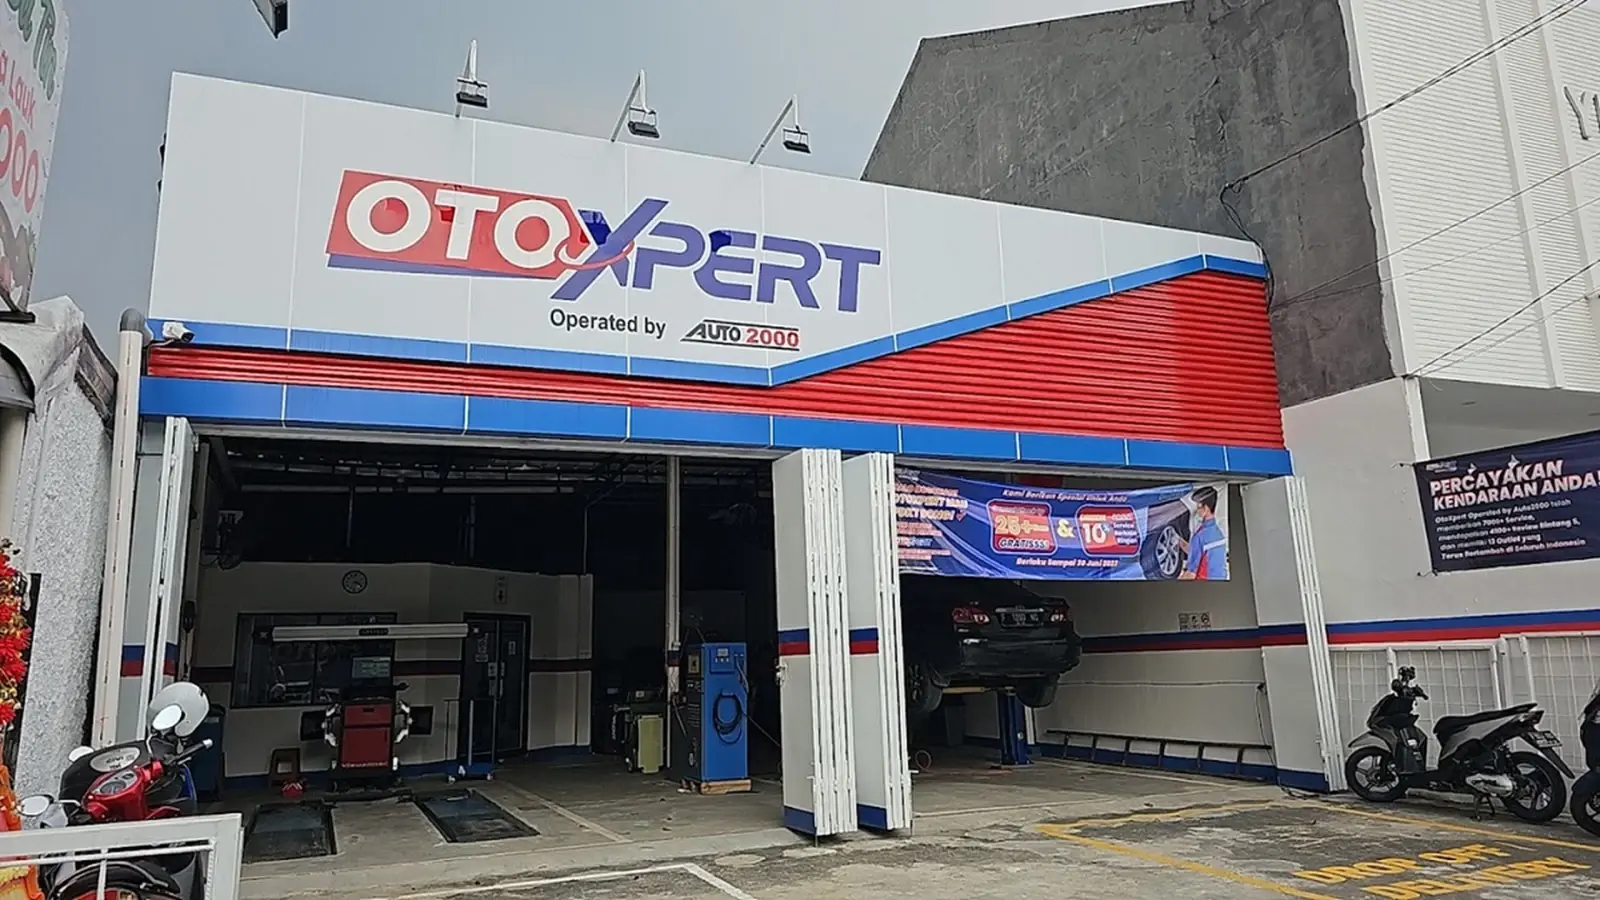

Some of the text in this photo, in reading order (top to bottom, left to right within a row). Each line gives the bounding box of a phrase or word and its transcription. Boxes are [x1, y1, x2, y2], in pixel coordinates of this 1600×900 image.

[346, 179, 881, 313] OTOXPERT
[550, 308, 667, 339] Operated by
[685, 322, 800, 348] AUTO 2000
[1430, 460, 1564, 497] PERCAYAKAN
[1002, 489, 1026, 498] Kami
[1025, 490, 1056, 500] Berikan
[1434, 481, 1538, 511] KENDARAAN
[1468, 507, 1501, 520] Operated
[1502, 506, 1513, 516] by
[1513, 501, 1550, 513] Auto2000
[1056, 518, 1076, 539] &
[1496, 535, 1521, 546] Outlet
[1522, 533, 1541, 544] yang
[1016, 557, 1046, 566] Berlaku
[1441, 552, 1464, 560] Terus
[1515, 543, 1546, 553] Seluruh
[1546, 538, 1586, 549] Indonesia
[1292, 843, 1511, 885] DROP OFF
[1360, 855, 1593, 900] DELIVERY
